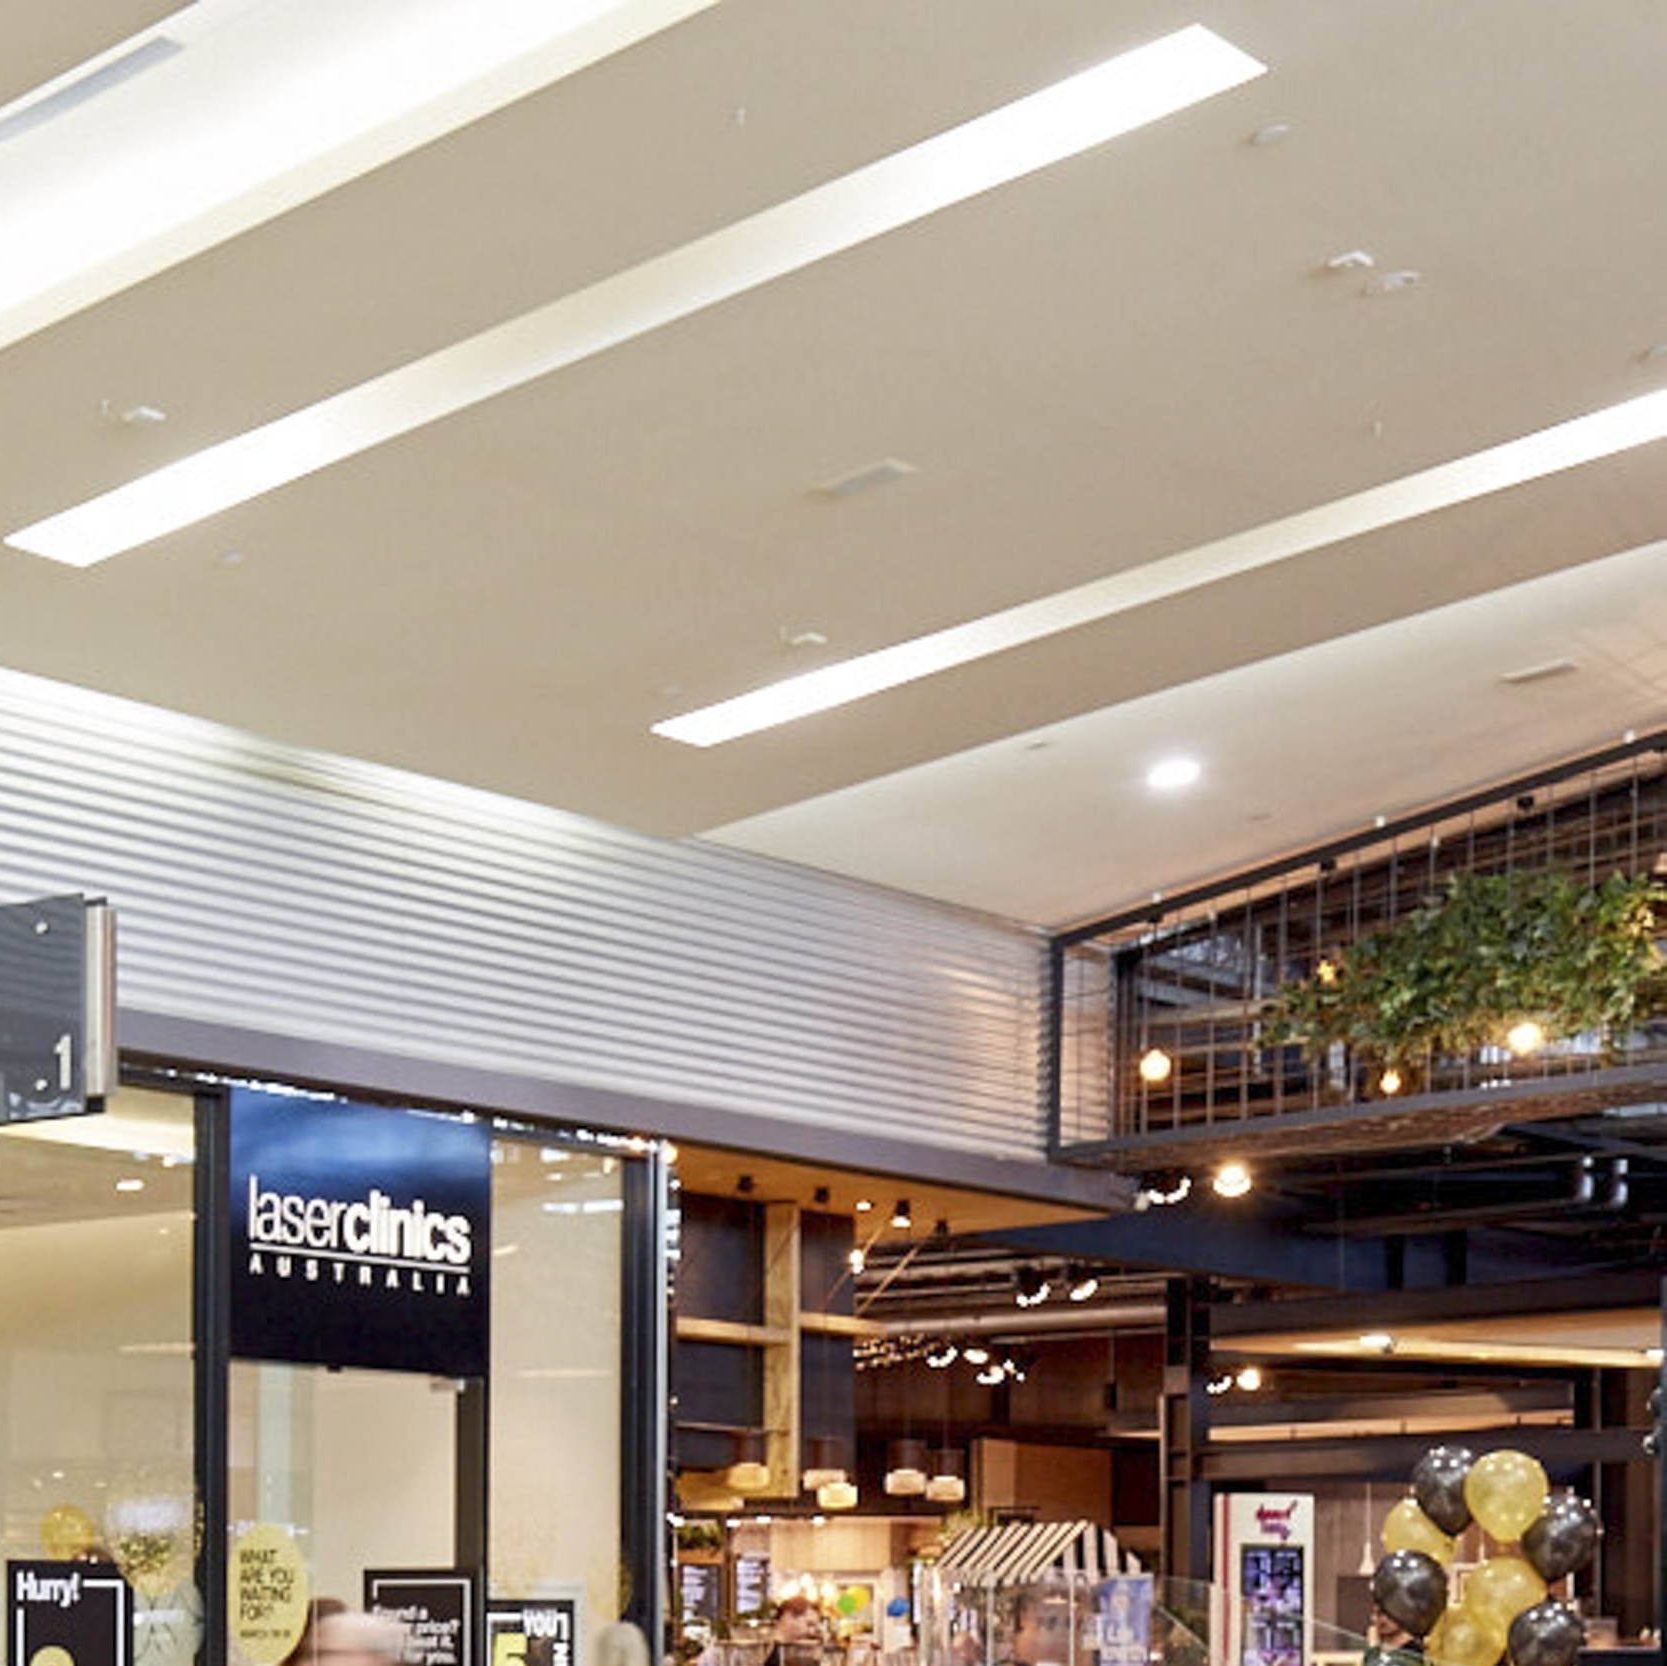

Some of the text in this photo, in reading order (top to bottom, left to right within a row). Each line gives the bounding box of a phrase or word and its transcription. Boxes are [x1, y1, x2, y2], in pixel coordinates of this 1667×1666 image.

[248, 1252, 471, 1297] AUSTRALIA
[240, 1548, 278, 1564] WHAT
[240, 1567, 295, 1584] ARE YOU
[16, 1568, 82, 1609] Hurry!
[240, 1585, 293, 1603] WAITING
